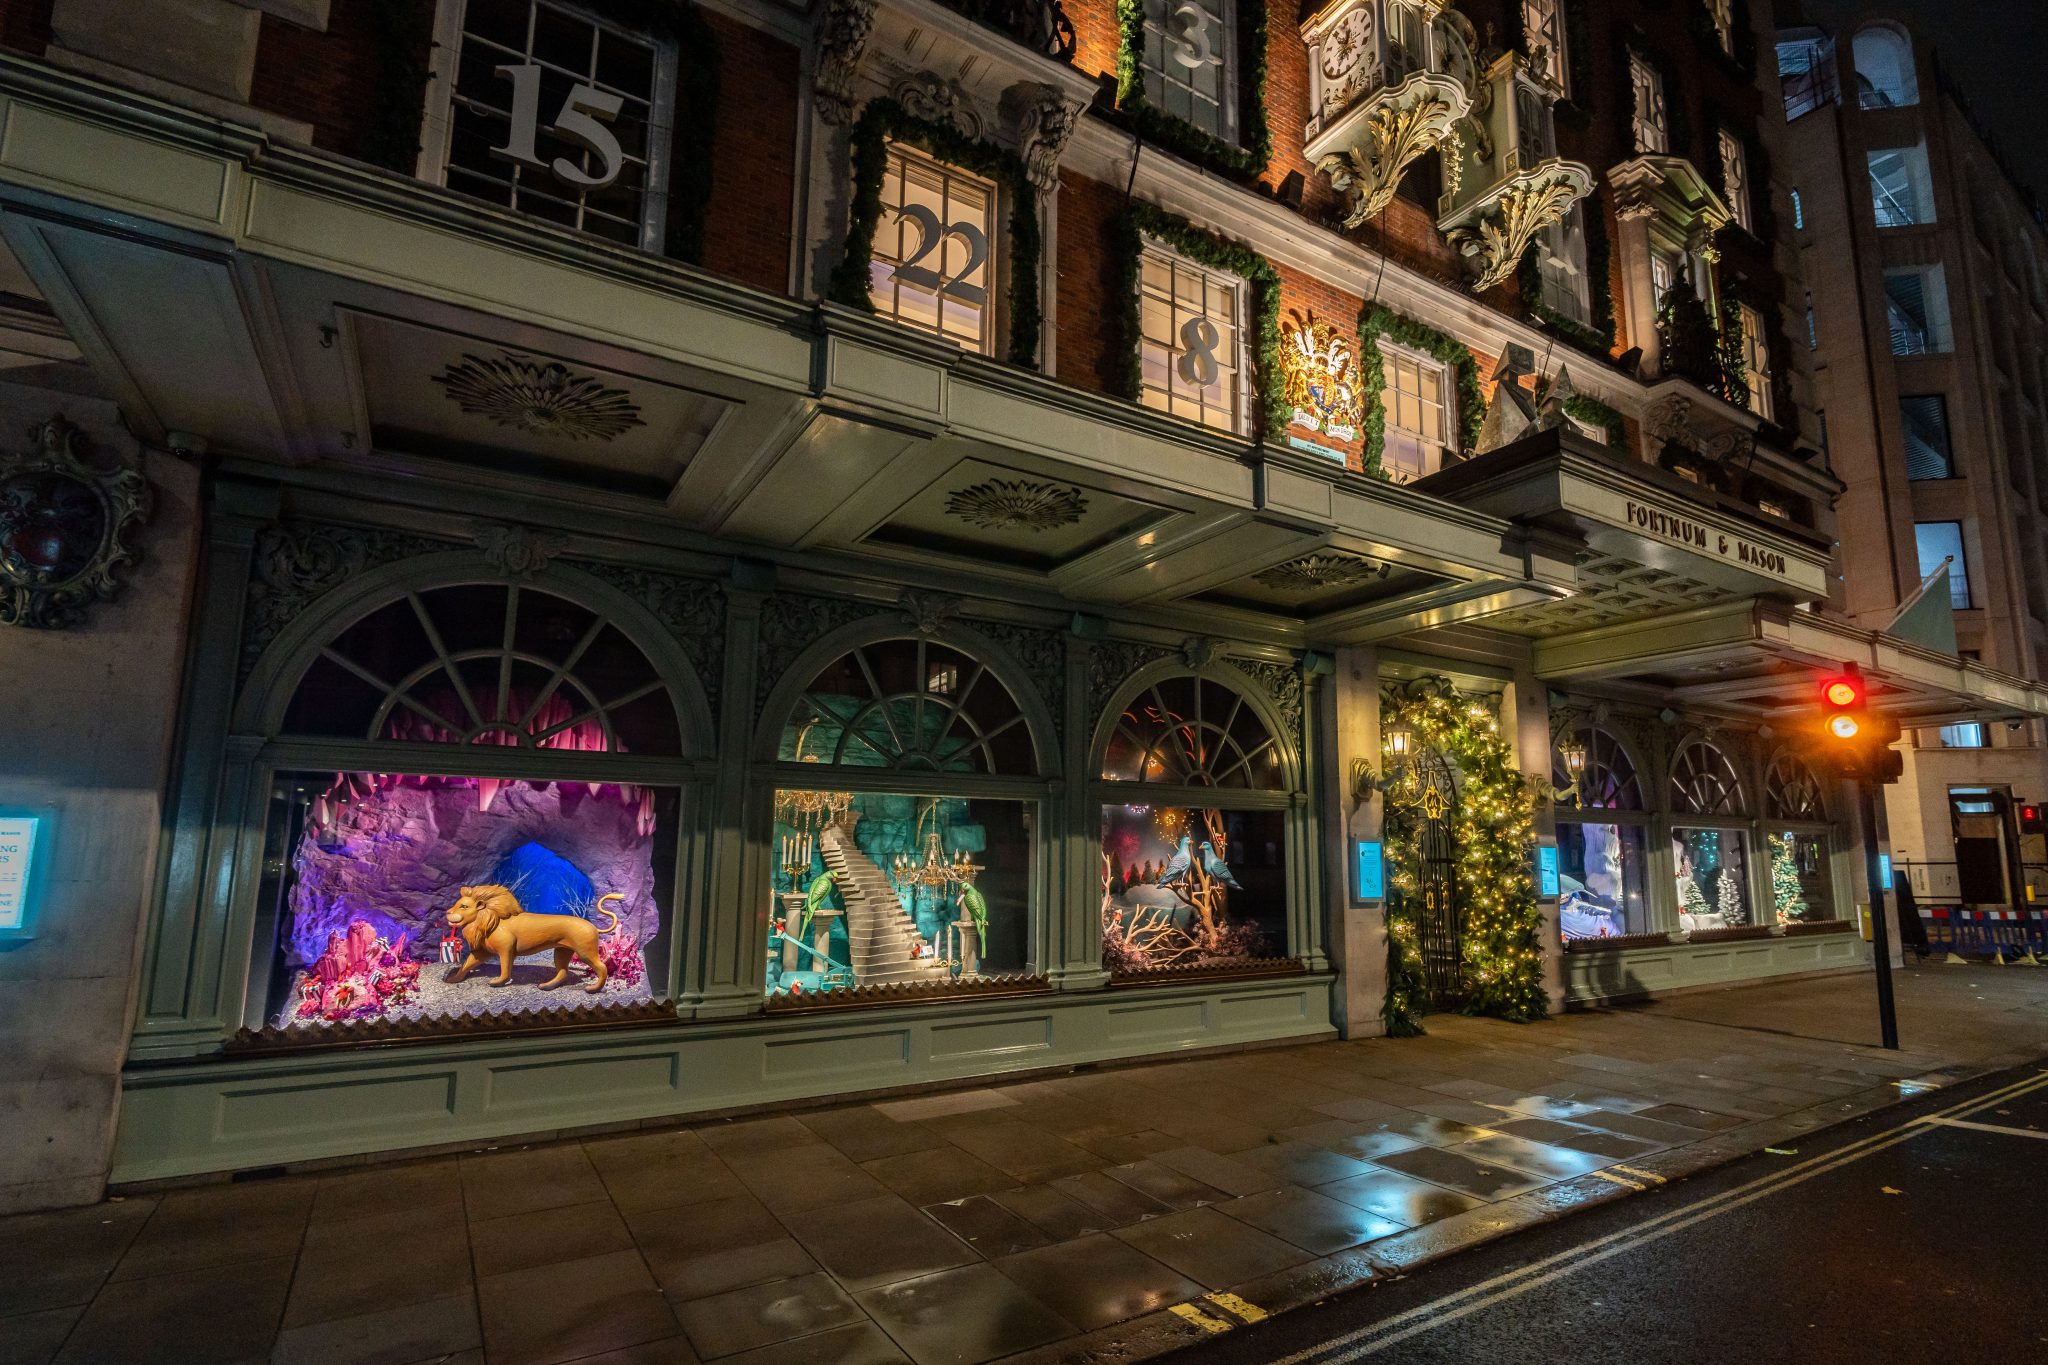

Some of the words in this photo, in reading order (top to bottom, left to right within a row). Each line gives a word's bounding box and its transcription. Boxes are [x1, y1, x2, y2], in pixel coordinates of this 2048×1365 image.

[1174, 0, 1211, 69] 3
[489, 64, 624, 191] 15
[890, 203, 988, 308] 22
[1177, 317, 1220, 388] 8
[1627, 501, 1707, 548] FORTNUM
[1718, 534, 1729, 555] &
[1738, 541, 1786, 574] MASON
